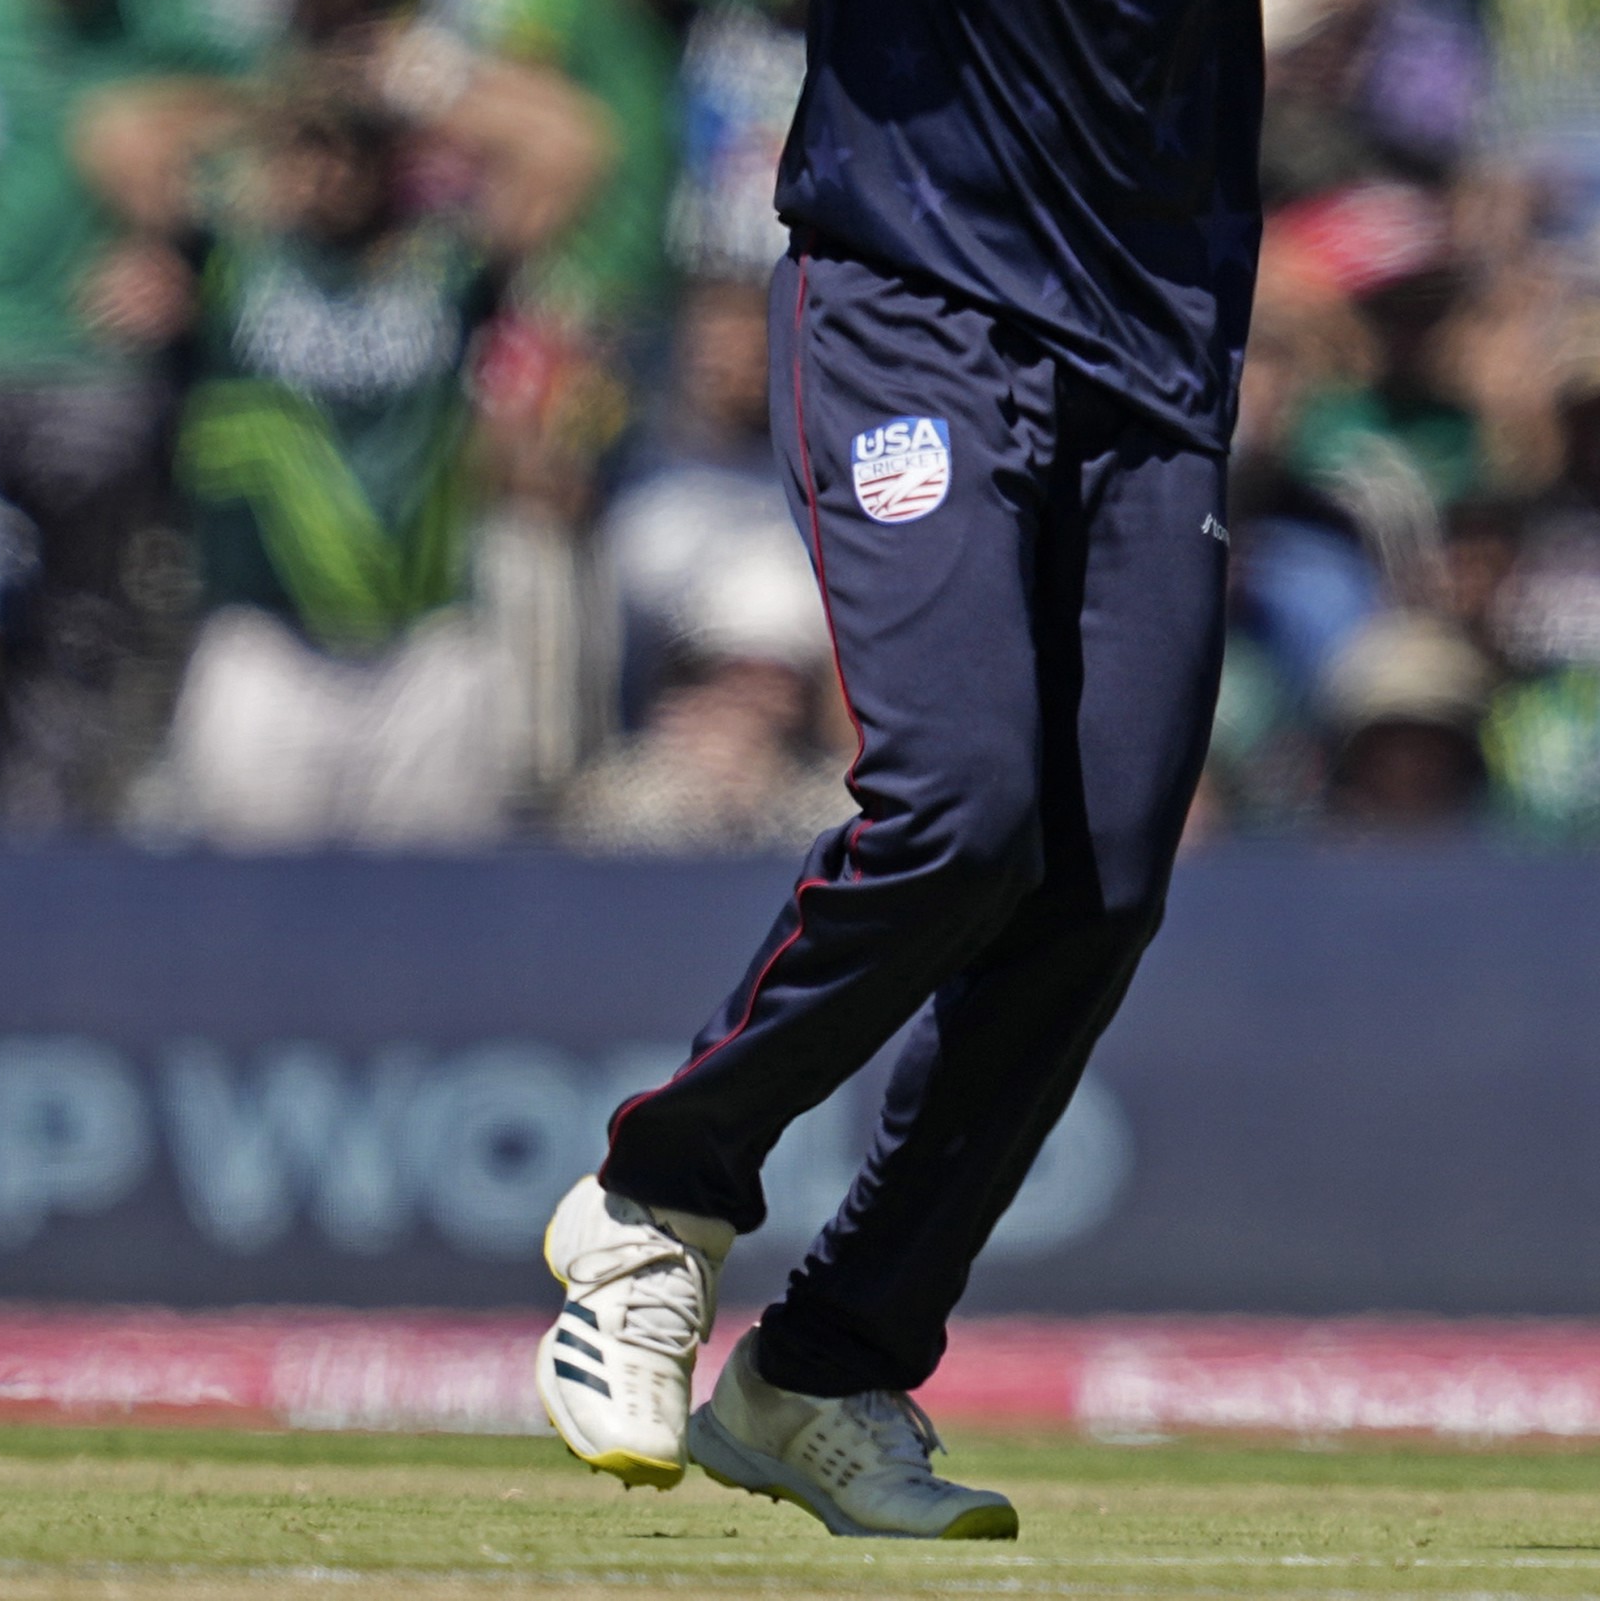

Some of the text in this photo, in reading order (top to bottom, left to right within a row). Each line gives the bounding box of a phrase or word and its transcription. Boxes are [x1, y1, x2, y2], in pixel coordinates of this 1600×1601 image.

[856, 418, 944, 461] USA
[858, 451, 942, 482] CRICKET
[156, 1036, 1137, 1260] WOD
